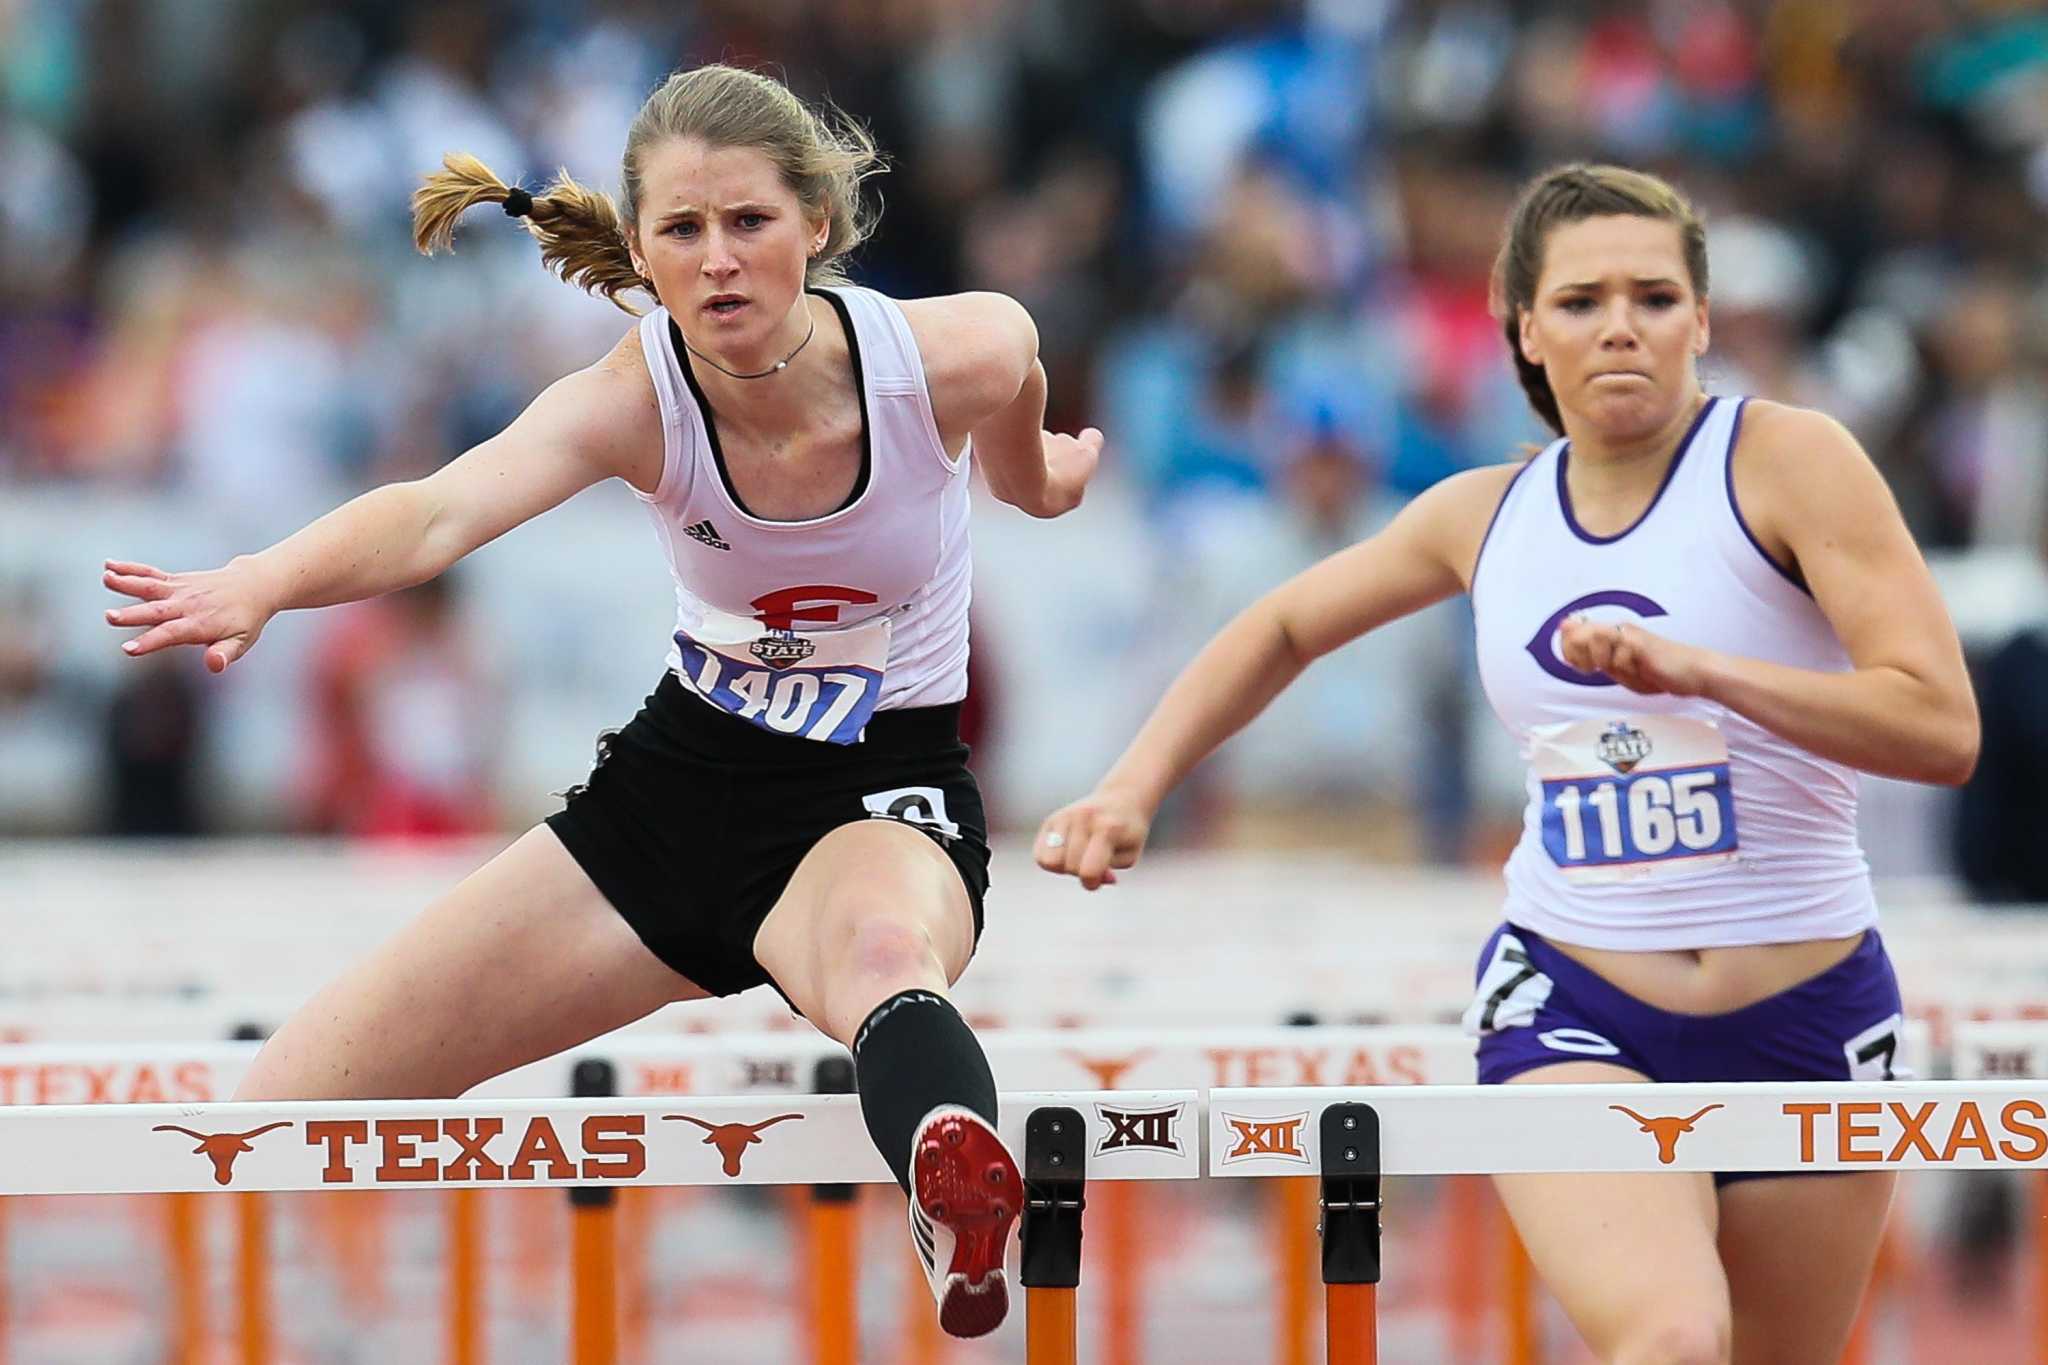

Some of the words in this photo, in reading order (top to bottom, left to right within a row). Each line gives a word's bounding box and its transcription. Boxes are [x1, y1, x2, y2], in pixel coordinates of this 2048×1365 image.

[683, 527, 731, 551] adidas
[751, 642, 814, 656] STATE
[1555, 771, 1722, 860] 1165
[1480, 948, 1536, 1029] 7
[0, 1060, 214, 1104] TEXAS
[1203, 1045, 1426, 1088] TEXAS
[304, 1114, 647, 1184] TEXAS
[1782, 1099, 2048, 1162] TEXAS
